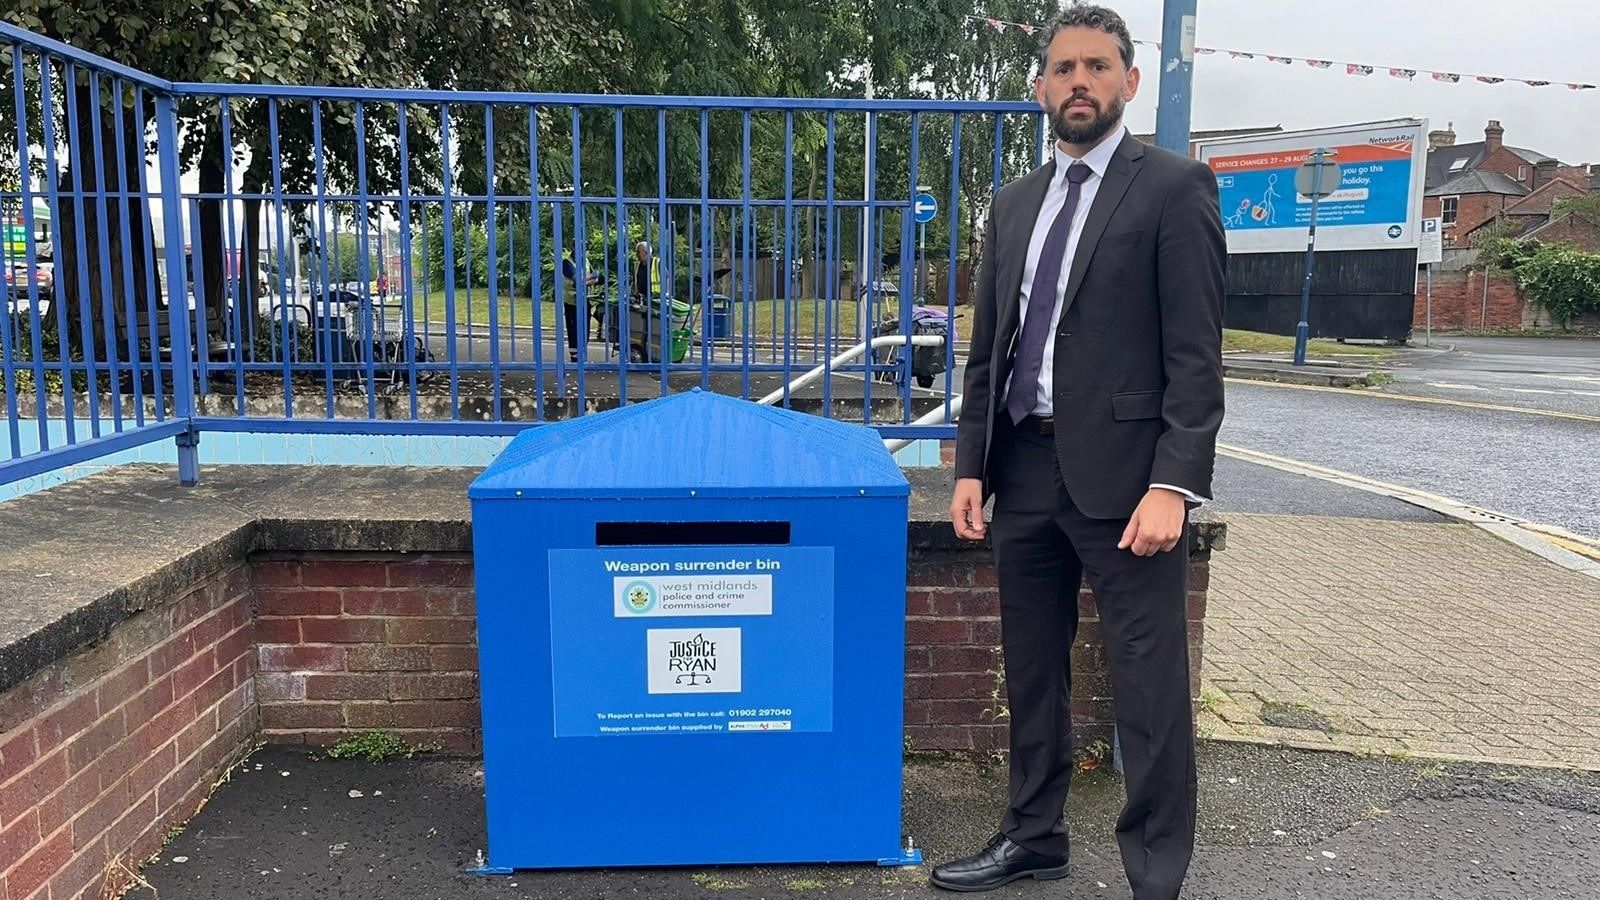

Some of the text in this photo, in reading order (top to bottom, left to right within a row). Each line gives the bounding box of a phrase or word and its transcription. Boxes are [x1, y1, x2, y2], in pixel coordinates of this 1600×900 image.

[1215, 160, 1239, 168] SERVICE
[1343, 168, 1356, 176] you
[1425, 220, 1434, 232] P
[605, 559, 780, 573] Weapon surrender bin
[662, 580, 758, 591] west midlands
[662, 592, 744, 602] police and crime
[662, 602, 731, 610] commissioner
[669, 640, 717, 658] JUSTICE
[669, 658, 717, 672] RYAN
